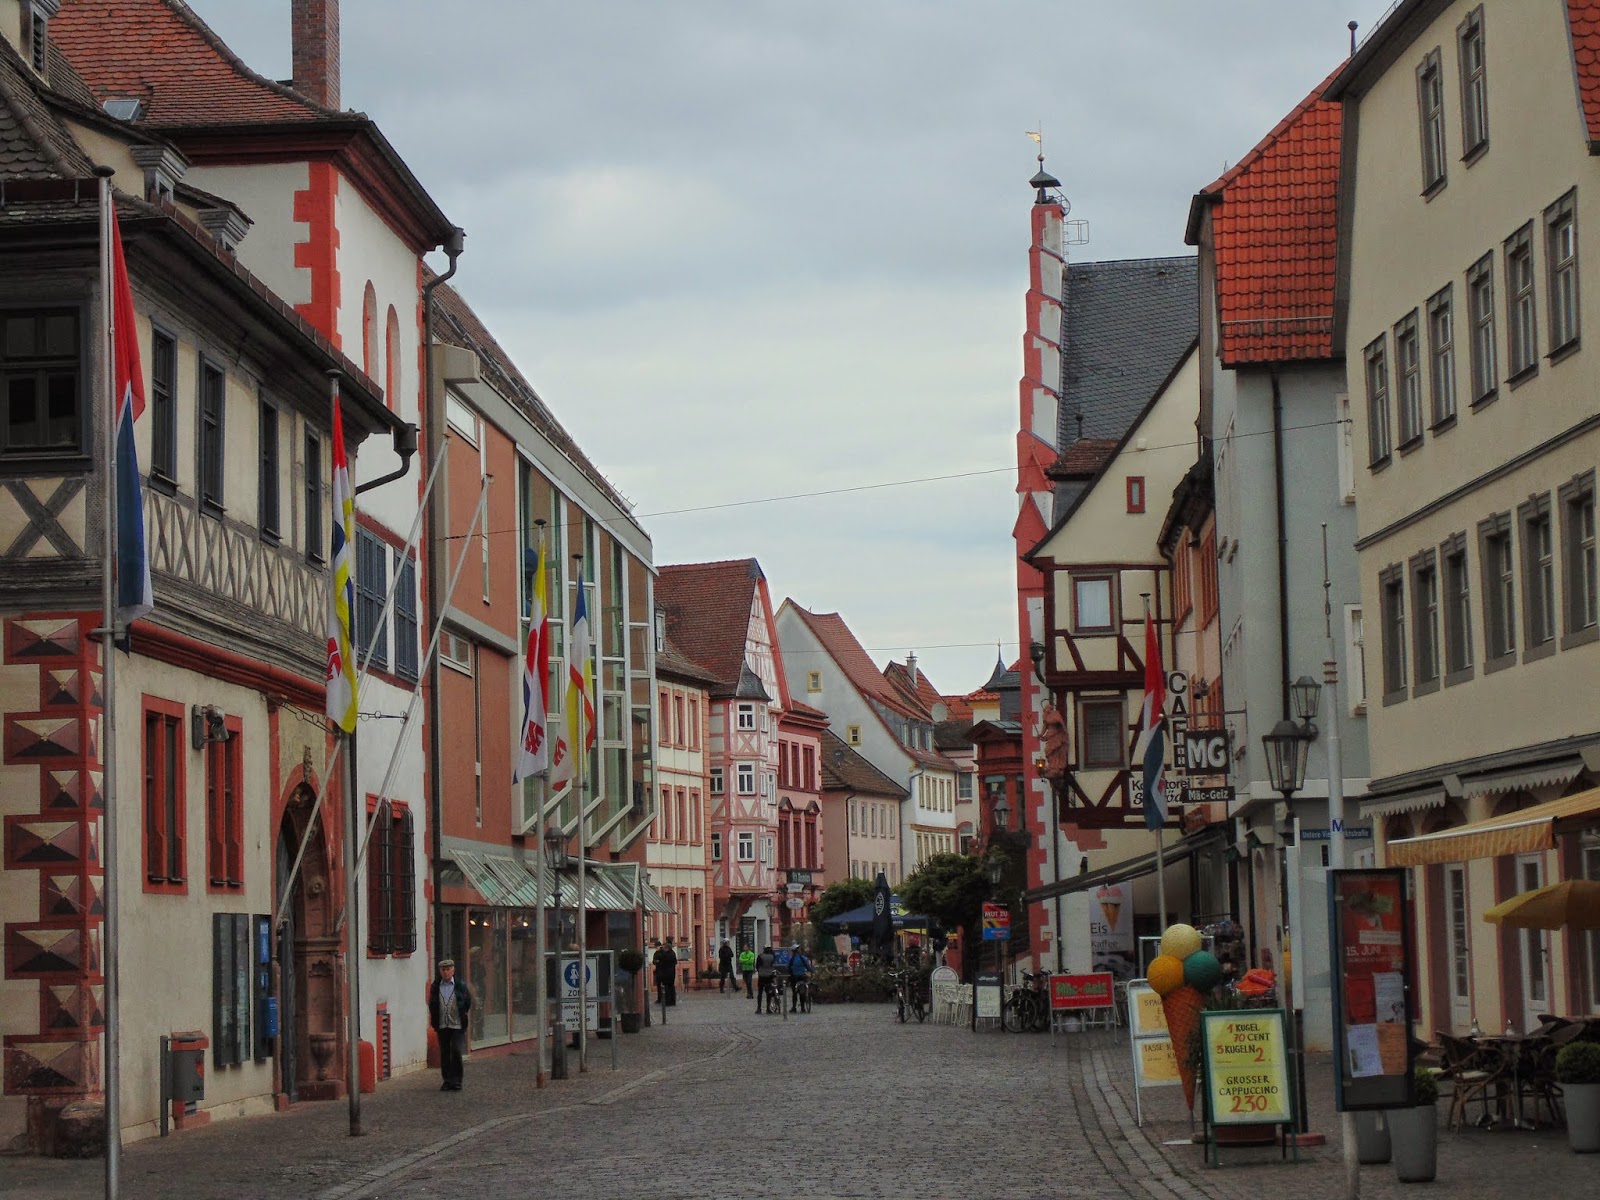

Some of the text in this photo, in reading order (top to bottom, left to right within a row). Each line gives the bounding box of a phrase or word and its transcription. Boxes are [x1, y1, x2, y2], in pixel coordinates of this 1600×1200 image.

[1187, 736, 1228, 769] MG
[1332, 819, 1344, 832] M
[1090, 922, 1108, 934] Eis
[1091, 940, 1118, 948] Kaffee
[1346, 946, 1359, 956] 15.
[1227, 1023, 1260, 1033] 1 KUGEL
[1233, 1032, 1271, 1042] 70 CENT
[1224, 1044, 1255, 1054] KUGELN
[1226, 1075, 1270, 1085] GROSSER
[1219, 1085, 1278, 1096] CAPPUCCINO
